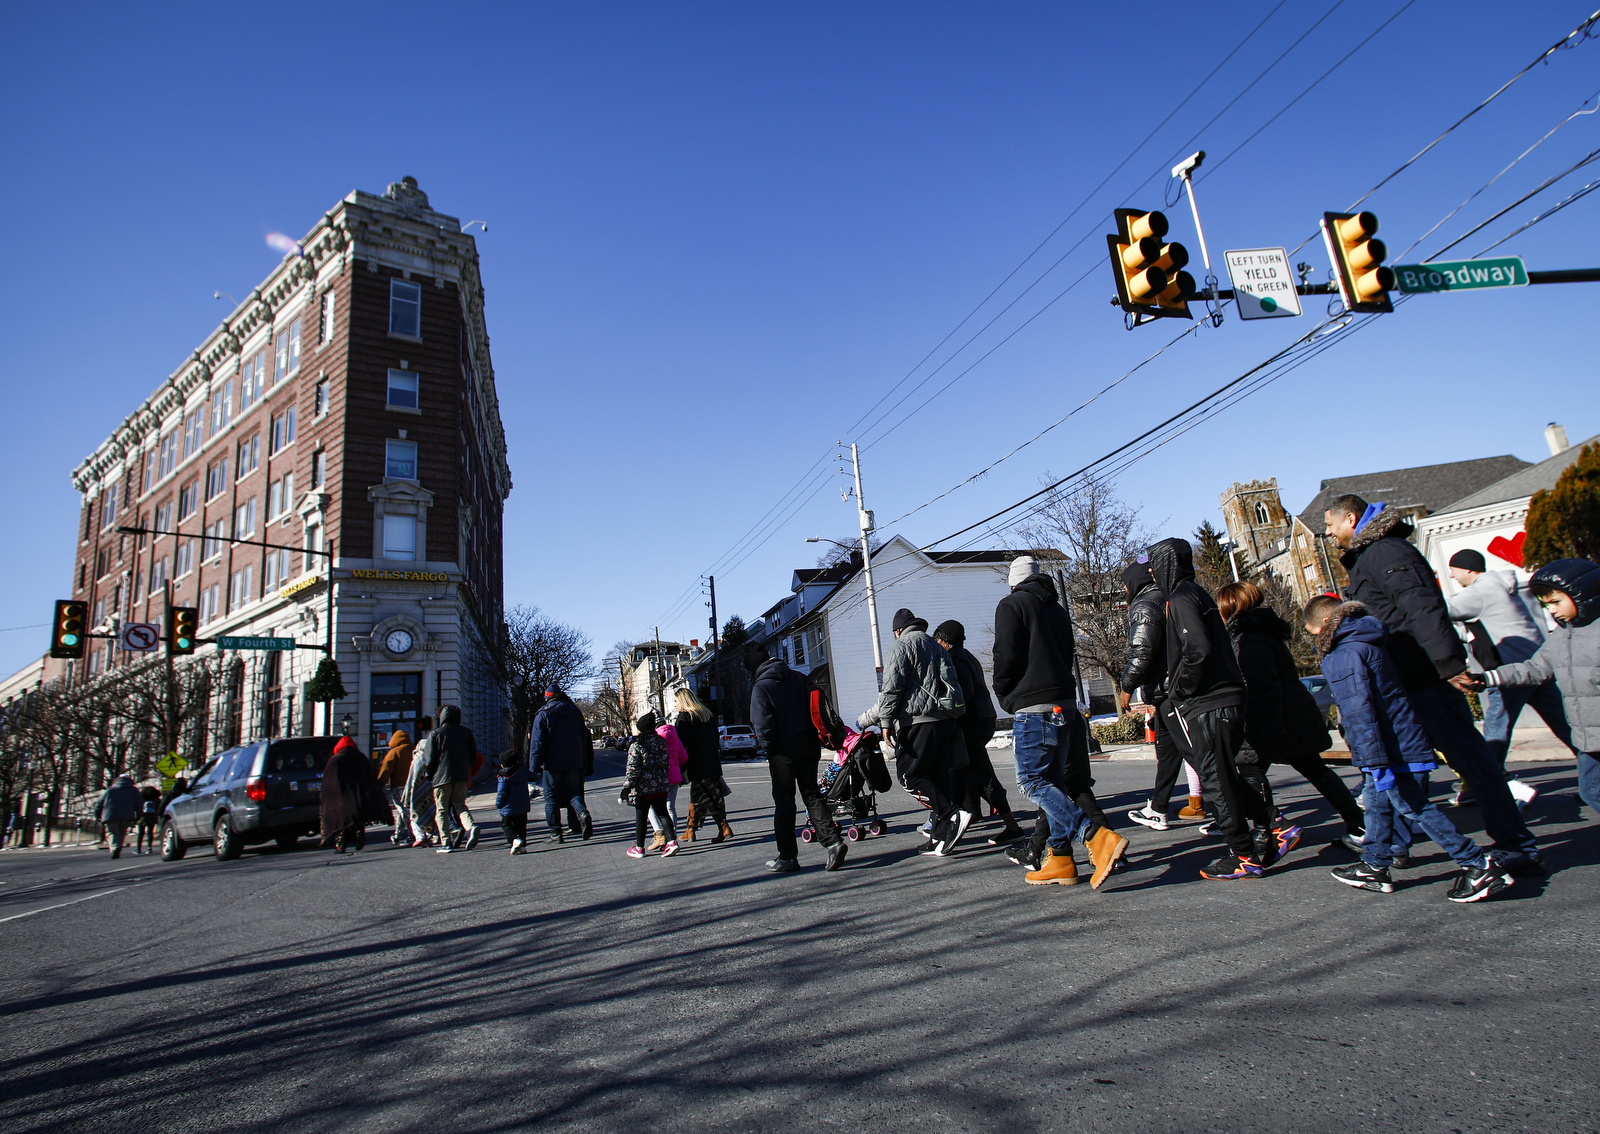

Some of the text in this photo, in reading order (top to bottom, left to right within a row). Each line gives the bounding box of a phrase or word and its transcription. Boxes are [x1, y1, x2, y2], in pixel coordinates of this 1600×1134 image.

[1231, 254, 1282, 266] LEFT TURN
[1244, 268, 1277, 280] YIELD
[1403, 264, 1515, 288] Broadway
[1240, 281, 1289, 294] ON GREEN
[351, 569, 448, 582] WELLS FARGO
[222, 638, 292, 648] W Fourth St
